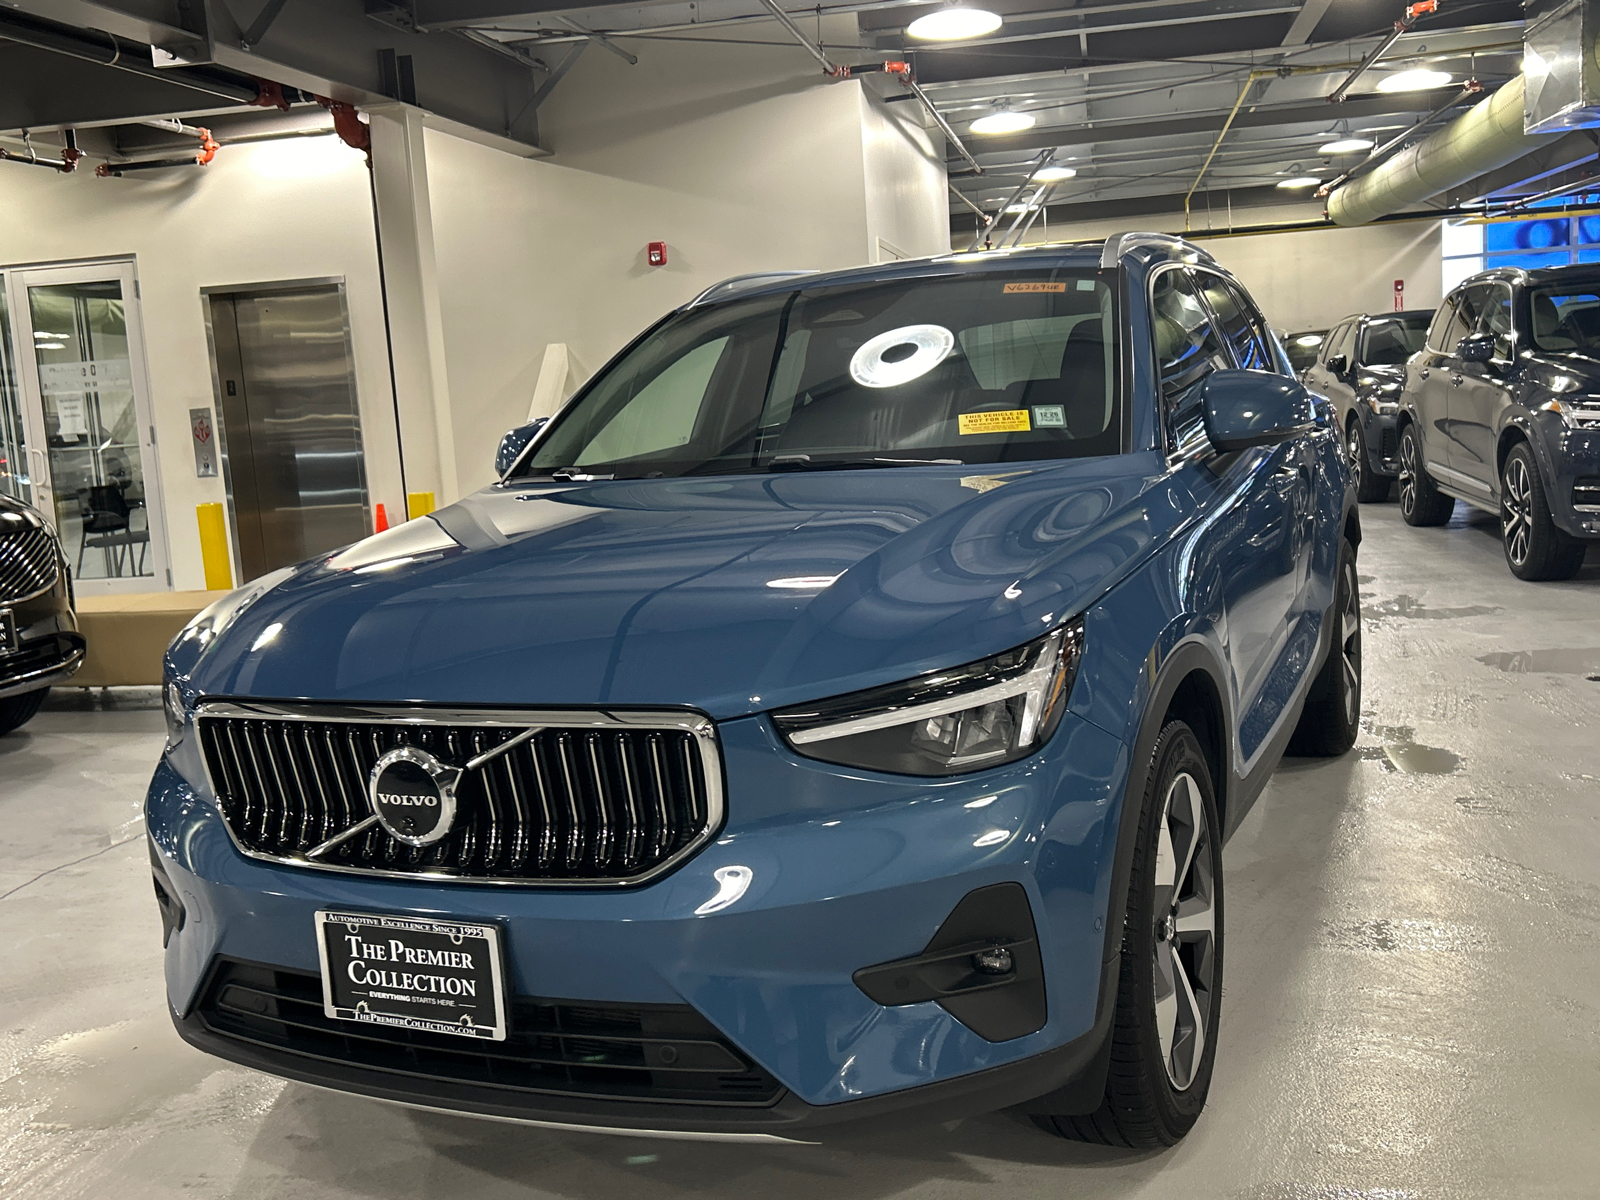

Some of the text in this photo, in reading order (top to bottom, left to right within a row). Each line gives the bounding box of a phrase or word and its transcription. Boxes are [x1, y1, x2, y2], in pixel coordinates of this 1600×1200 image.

[377, 793, 437, 806] VOLVO
[327, 913, 483, 937] AUTOMOTIVE EXCELLENCE SINCE 1995
[344, 935, 475, 970] THE PREMIER
[347, 960, 476, 997] COLLECTION
[369, 990, 411, 1002] EVERYTHING
[411, 996, 436, 1005] STARTS
[353, 1011, 477, 1036] THEPREMIERCOLLECTION.COM
